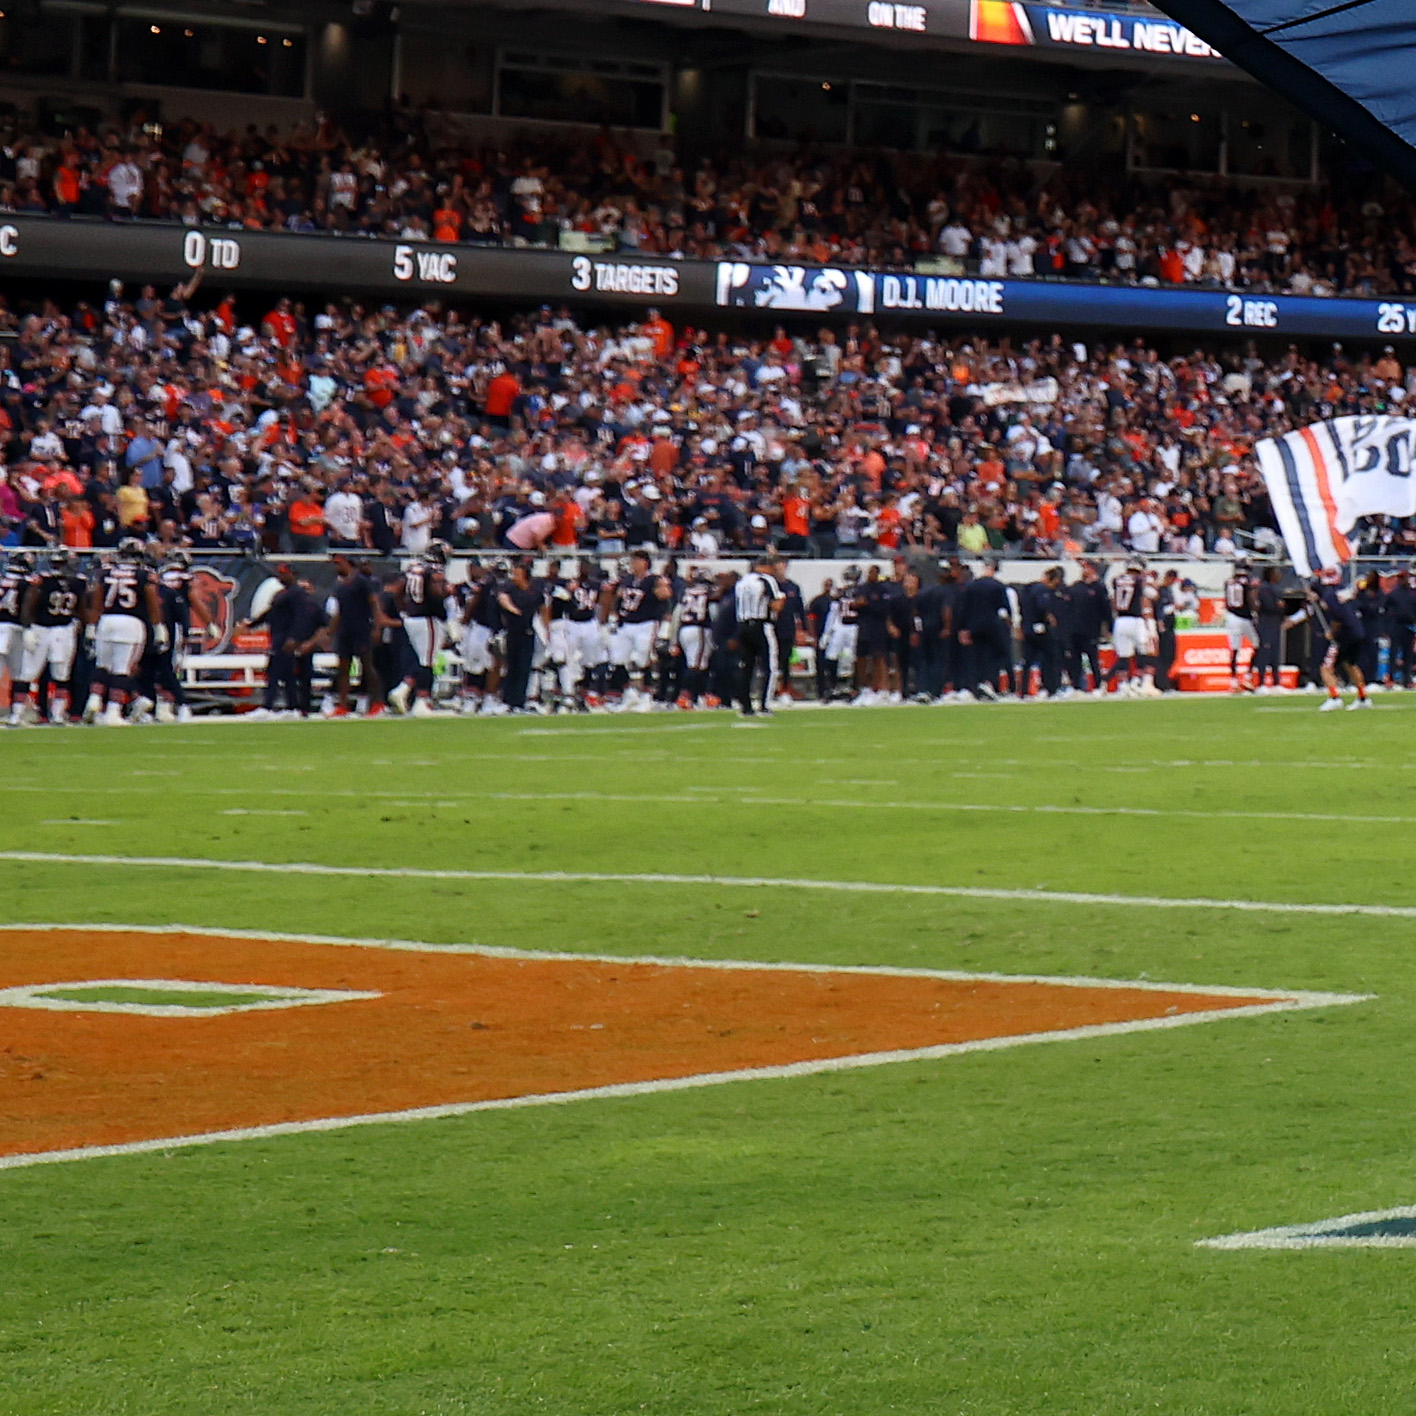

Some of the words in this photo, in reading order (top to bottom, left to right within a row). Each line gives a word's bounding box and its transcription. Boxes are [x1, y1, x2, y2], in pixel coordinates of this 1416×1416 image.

[868, 1, 893, 27] ON
[895, 4, 927, 31] THE
[1047, 12, 1130, 48] WE'LL
[184, 231, 205, 267] 0
[210, 239, 239, 268] TD
[394, 245, 413, 279] 5
[416, 252, 457, 282] YAC
[572, 256, 592, 291] 3
[594, 263, 679, 295] TARGETS
[883, 275, 922, 308] D.J.
[926, 278, 1003, 312] MOORE
[1226, 295, 1242, 325] 2
[1244, 301, 1278, 327] REC
[1377, 303, 1405, 333] 25
[104, 577, 138, 608] 75
